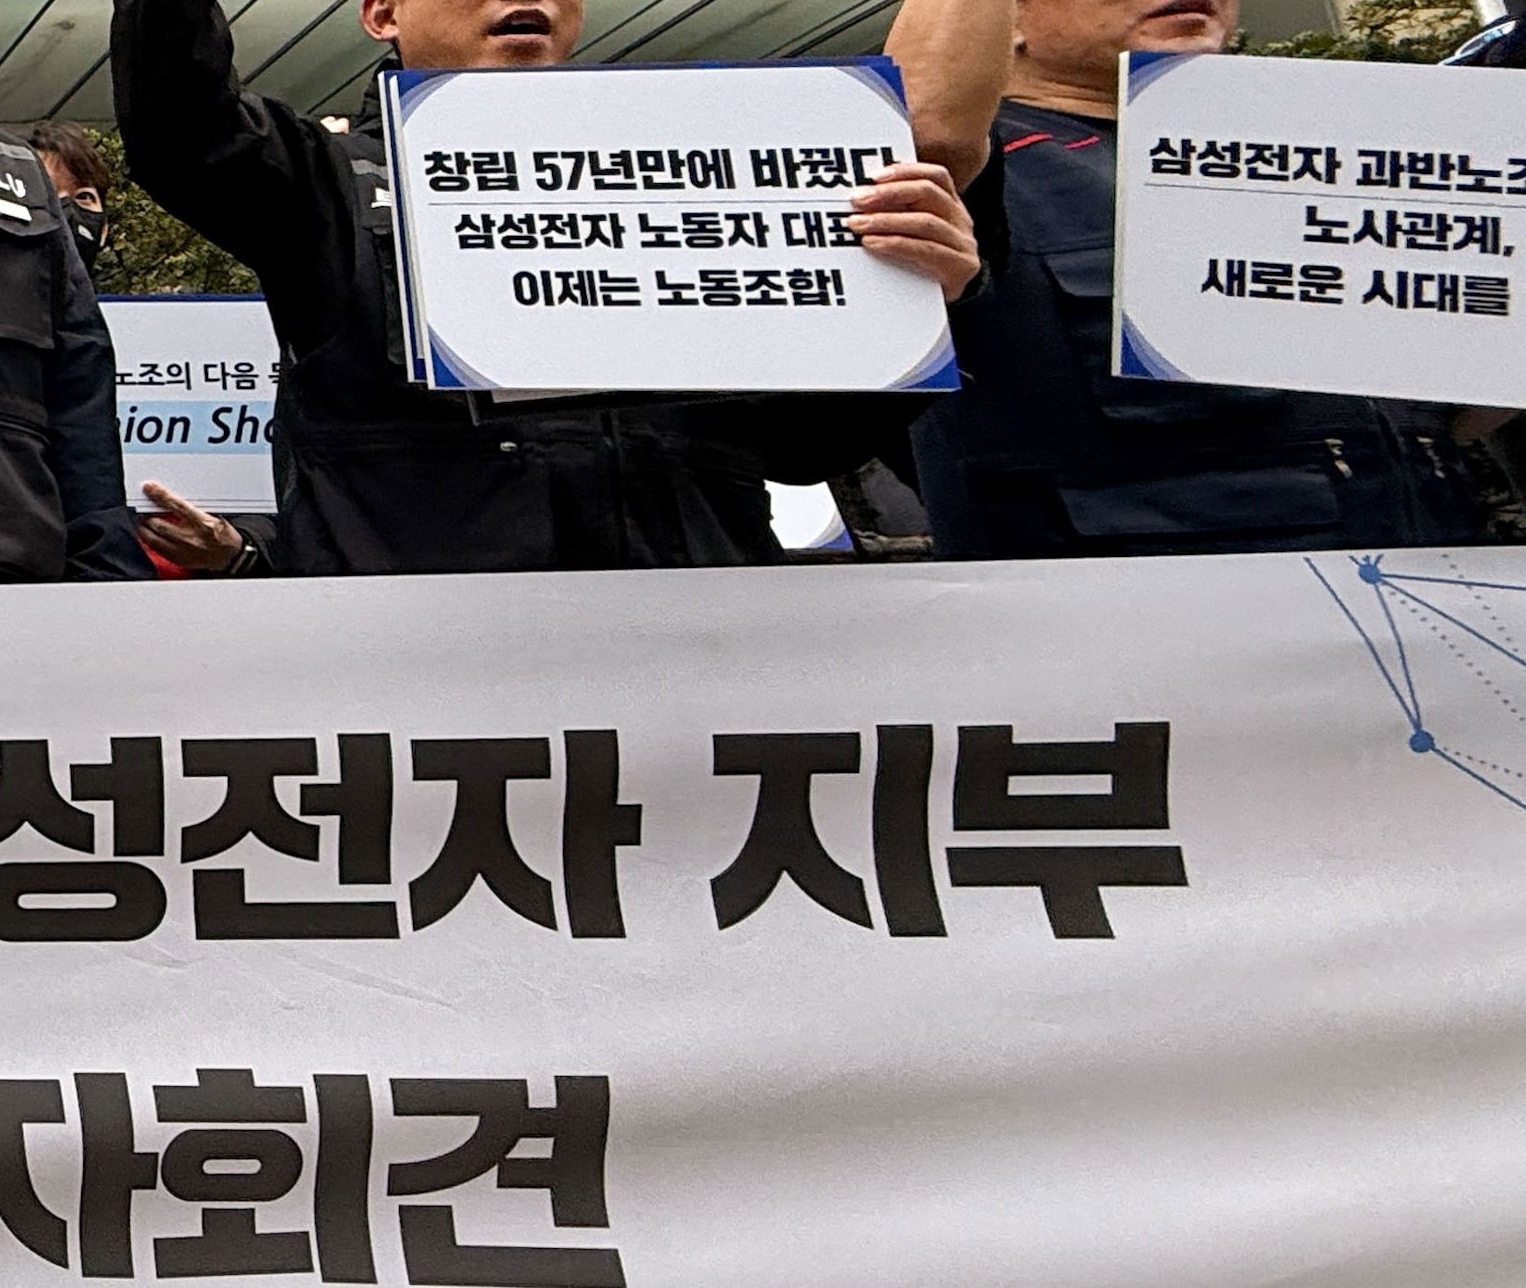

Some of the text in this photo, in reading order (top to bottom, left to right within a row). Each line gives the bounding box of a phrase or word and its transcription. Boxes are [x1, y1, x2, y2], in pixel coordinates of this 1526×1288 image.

[424, 147, 901, 191] 창립 57년만에 바꿨다
[1150, 138, 1341, 184] 삼성전자
[455, 212, 864, 249] 삼성전자 노동자 대표
[1304, 206, 1513, 256] 노사관계,
[513, 269, 845, 306] 이제는 노동조합!
[1202, 259, 1509, 316] 새로운 시대를
[115, 362, 192, 391] 노조의
[204, 362, 259, 390] 다음
[124, 405, 191, 444] ion
[710, 722, 1188, 938] 지부
